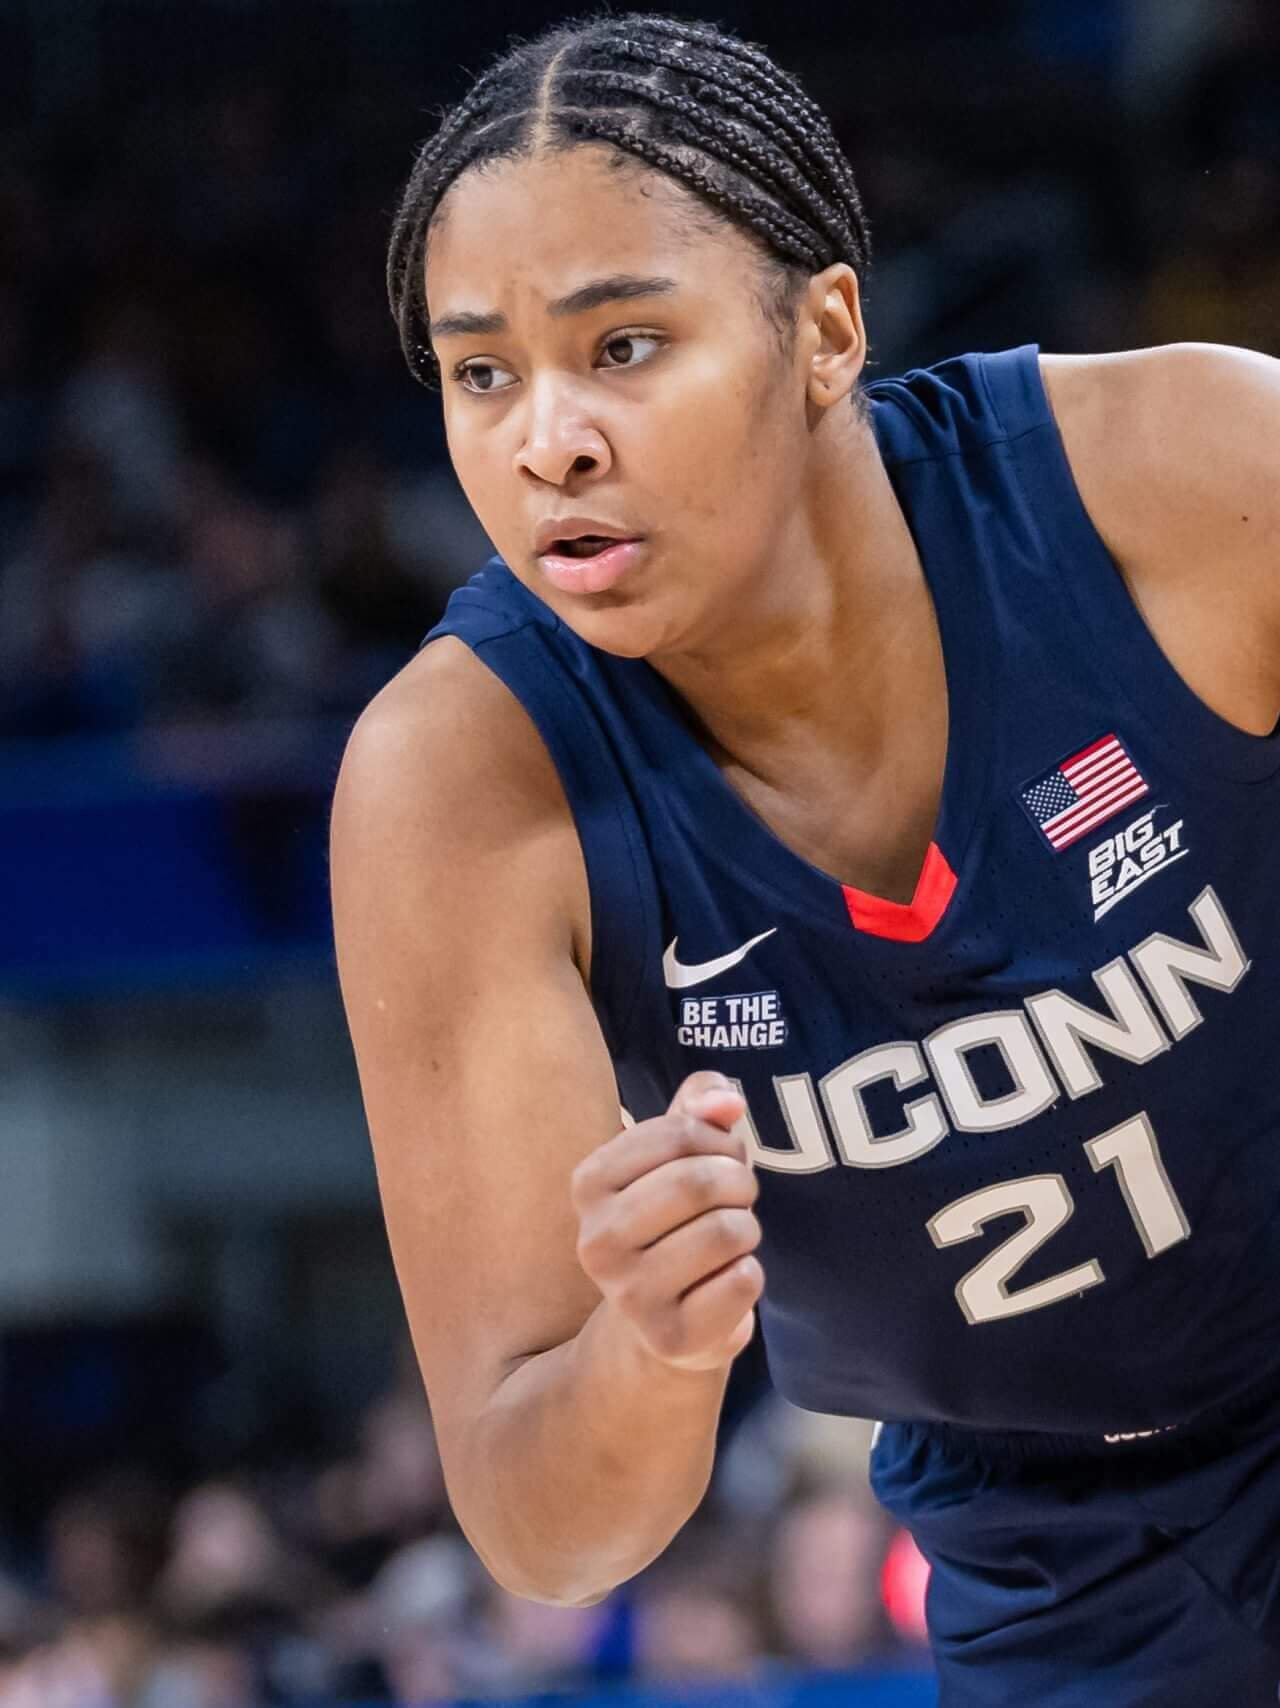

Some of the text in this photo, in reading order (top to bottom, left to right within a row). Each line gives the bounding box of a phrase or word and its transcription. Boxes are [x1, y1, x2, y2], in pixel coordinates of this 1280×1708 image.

[1088, 808, 1157, 878] BIG
[1091, 819, 1184, 905] EAST
[677, 1020, 786, 1048] CHANGE
[683, 994, 778, 1025] BE THE
[727, 884, 1251, 1175] UCONN
[926, 1110, 1191, 1326] 21
